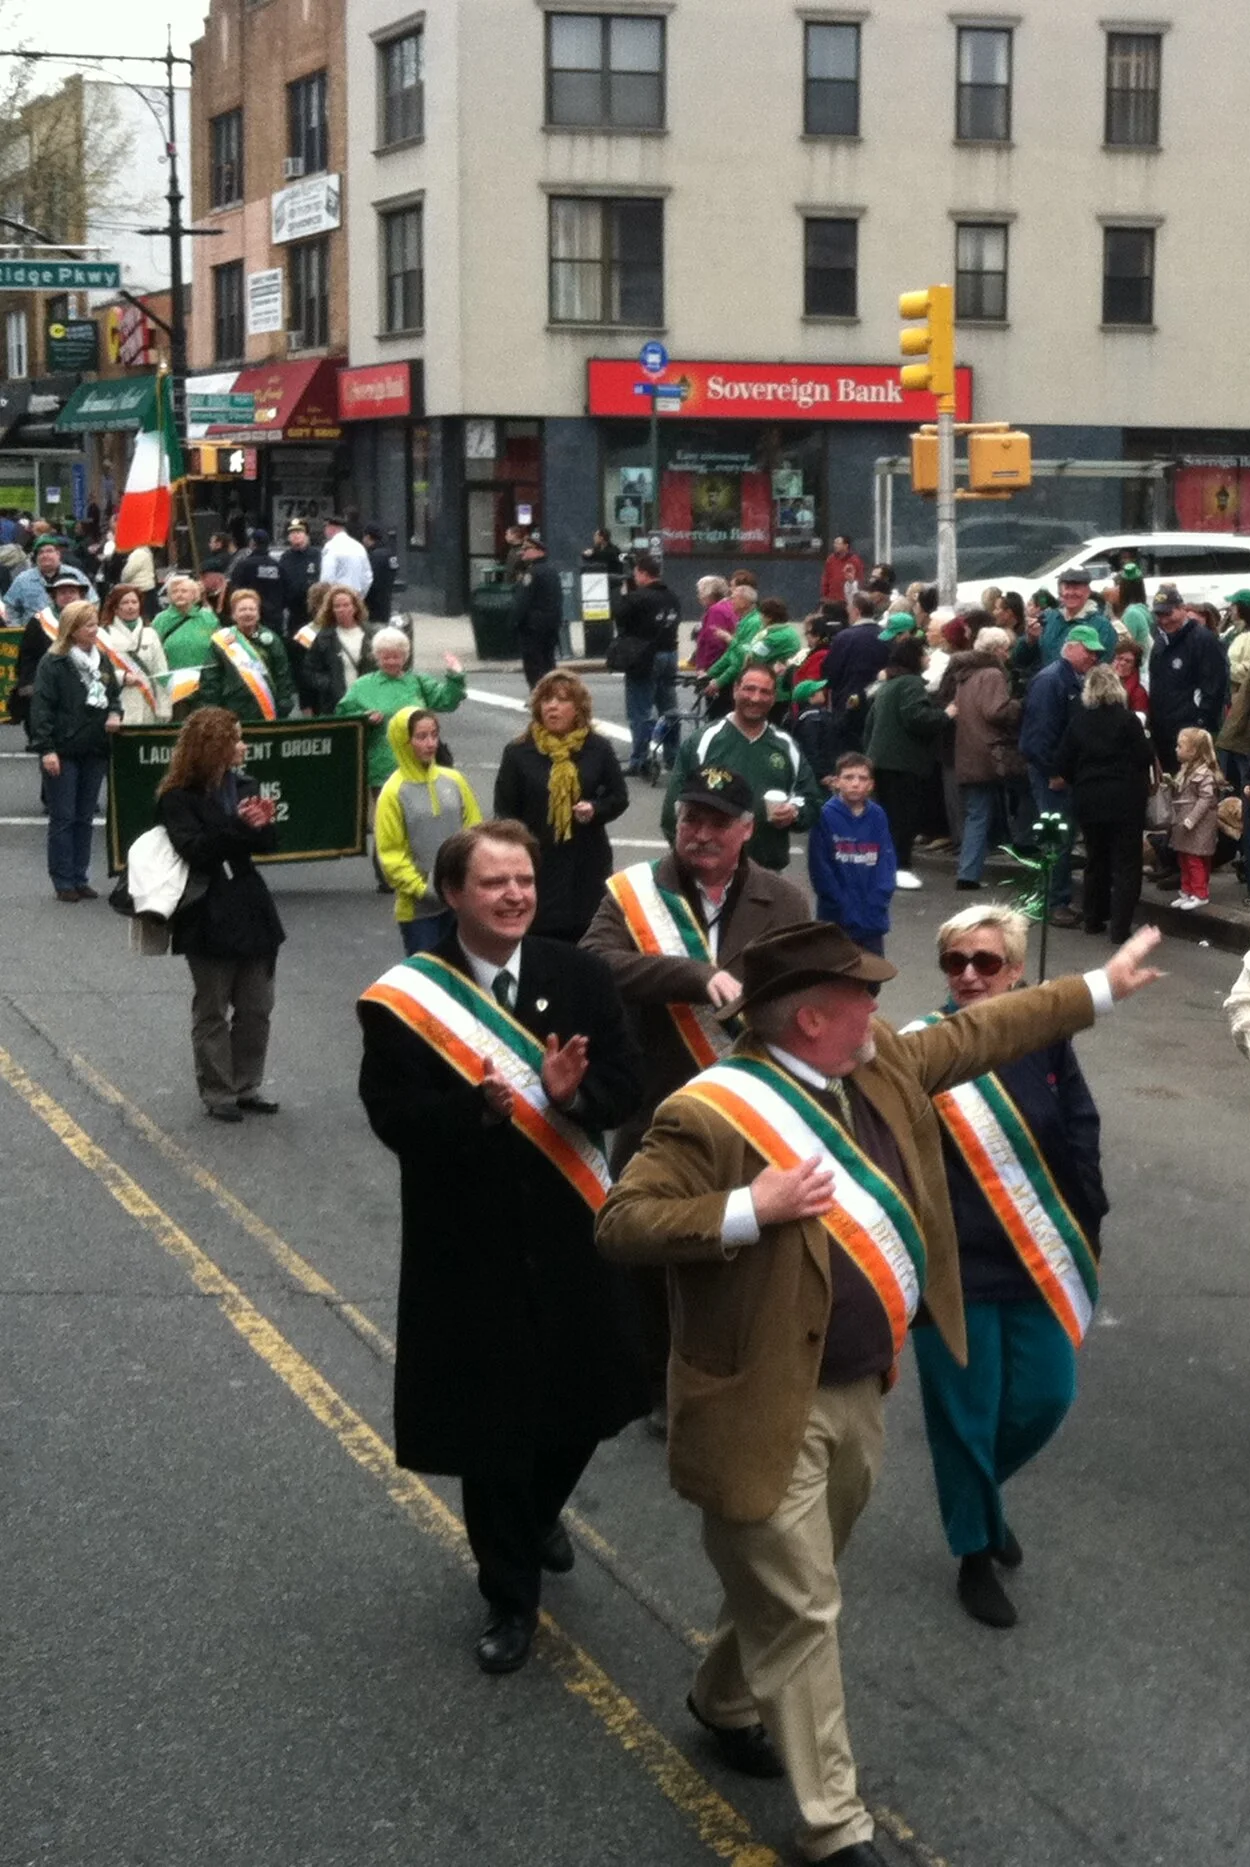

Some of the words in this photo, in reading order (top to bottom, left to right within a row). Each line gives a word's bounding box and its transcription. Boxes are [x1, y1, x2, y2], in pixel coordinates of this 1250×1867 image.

[0, 267, 53, 286] idge
[59, 267, 117, 287] Pkwy
[707, 376, 830, 408] Sovereign
[838, 378, 903, 403] Bank
[281, 737, 332, 758] ORDER
